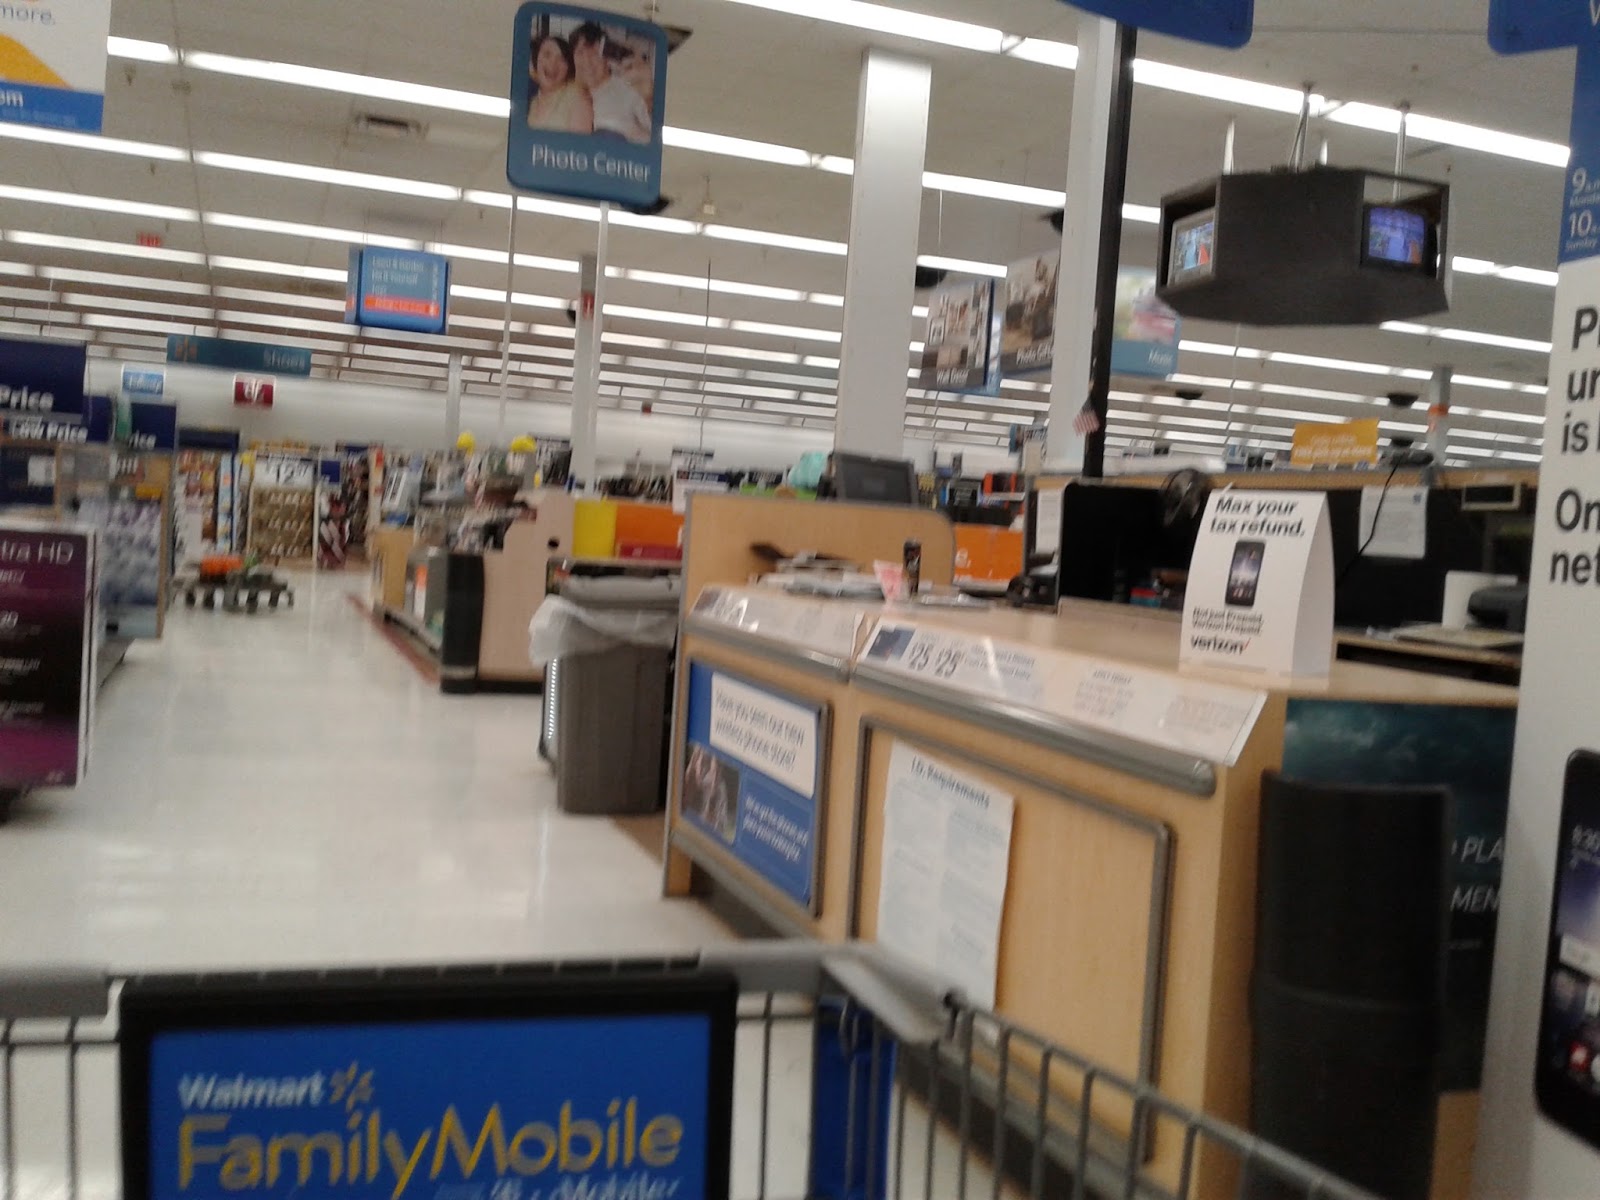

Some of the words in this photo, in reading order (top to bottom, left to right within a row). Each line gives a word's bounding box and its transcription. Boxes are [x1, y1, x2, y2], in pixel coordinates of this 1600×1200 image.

[531, 143, 588, 172] Photo
[593, 150, 650, 182] Center
[1572, 307, 1600, 350] P
[1561, 412, 1588, 455] is
[1215, 496, 1252, 514] Max
[1255, 500, 1298, 517] your
[1211, 517, 1239, 534] tax
[38, 541, 74, 566] HD
[1190, 636, 1244, 655] verizon
[179, 1070, 327, 1110] Walmart
